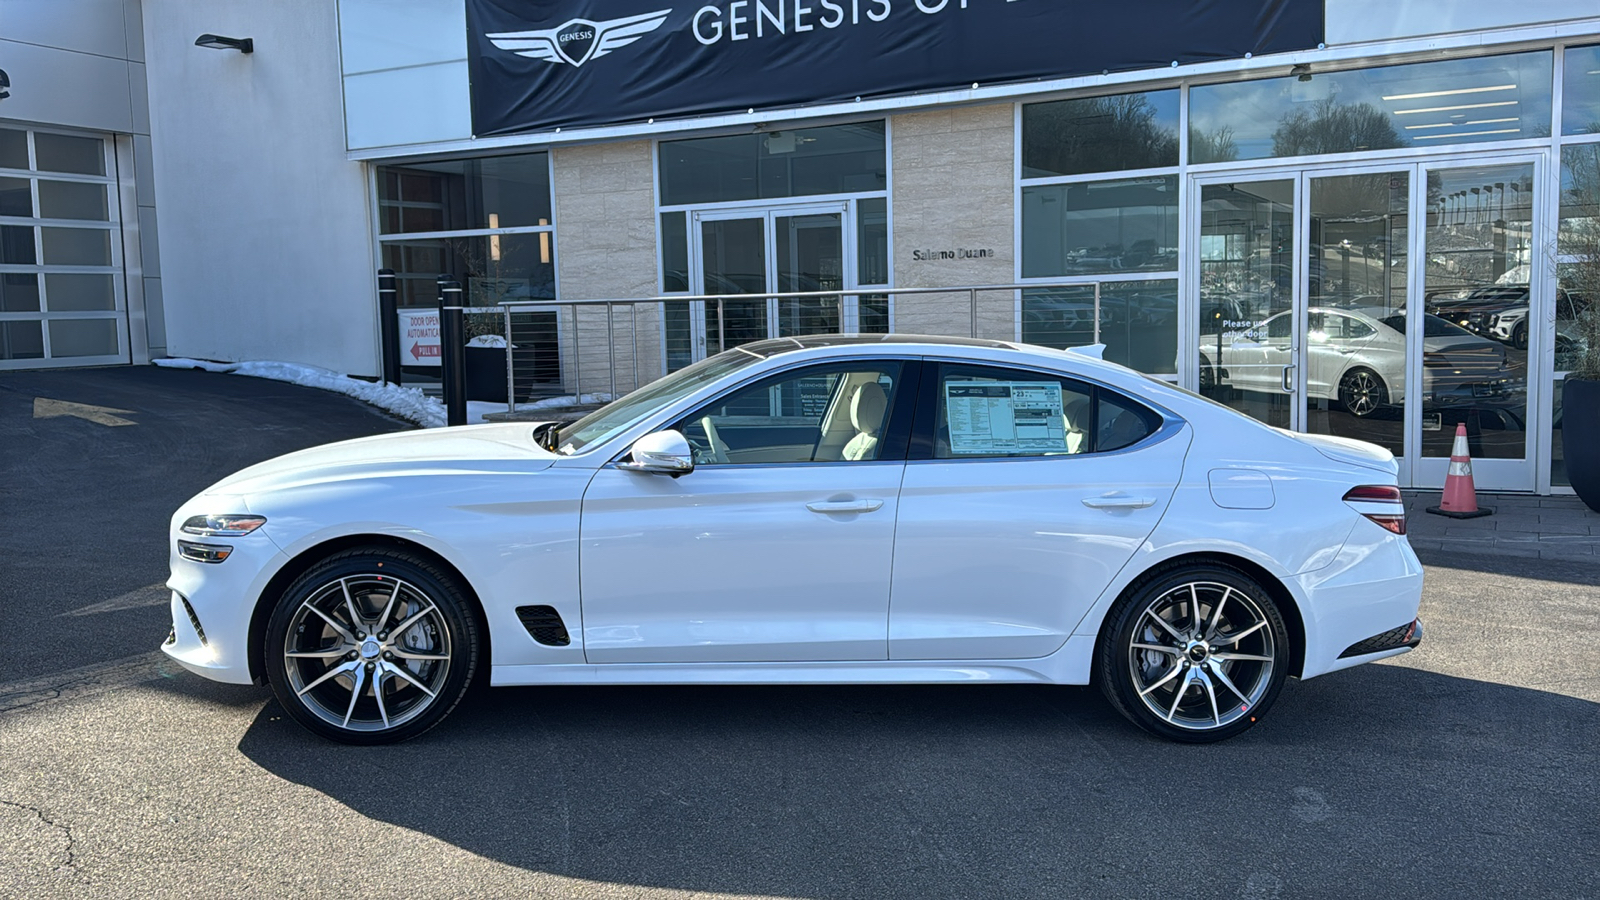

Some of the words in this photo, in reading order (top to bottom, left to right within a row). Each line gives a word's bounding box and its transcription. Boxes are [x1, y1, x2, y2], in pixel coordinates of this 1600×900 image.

[692, 0, 892, 45] GENESIS
[560, 31, 592, 42] GENESIS
[957, 248, 994, 259] Duane
[411, 317, 424, 326] DOOR
[425, 316, 439, 326] OPEN
[1222, 319, 1251, 328] Please
[1253, 320, 1268, 328] use
[407, 328, 441, 338] AUTOMATICA
[1222, 329, 1247, 338] other
[1247, 329, 1268, 338] door
[419, 346, 431, 356] PULL
[431, 346, 438, 355] IN
